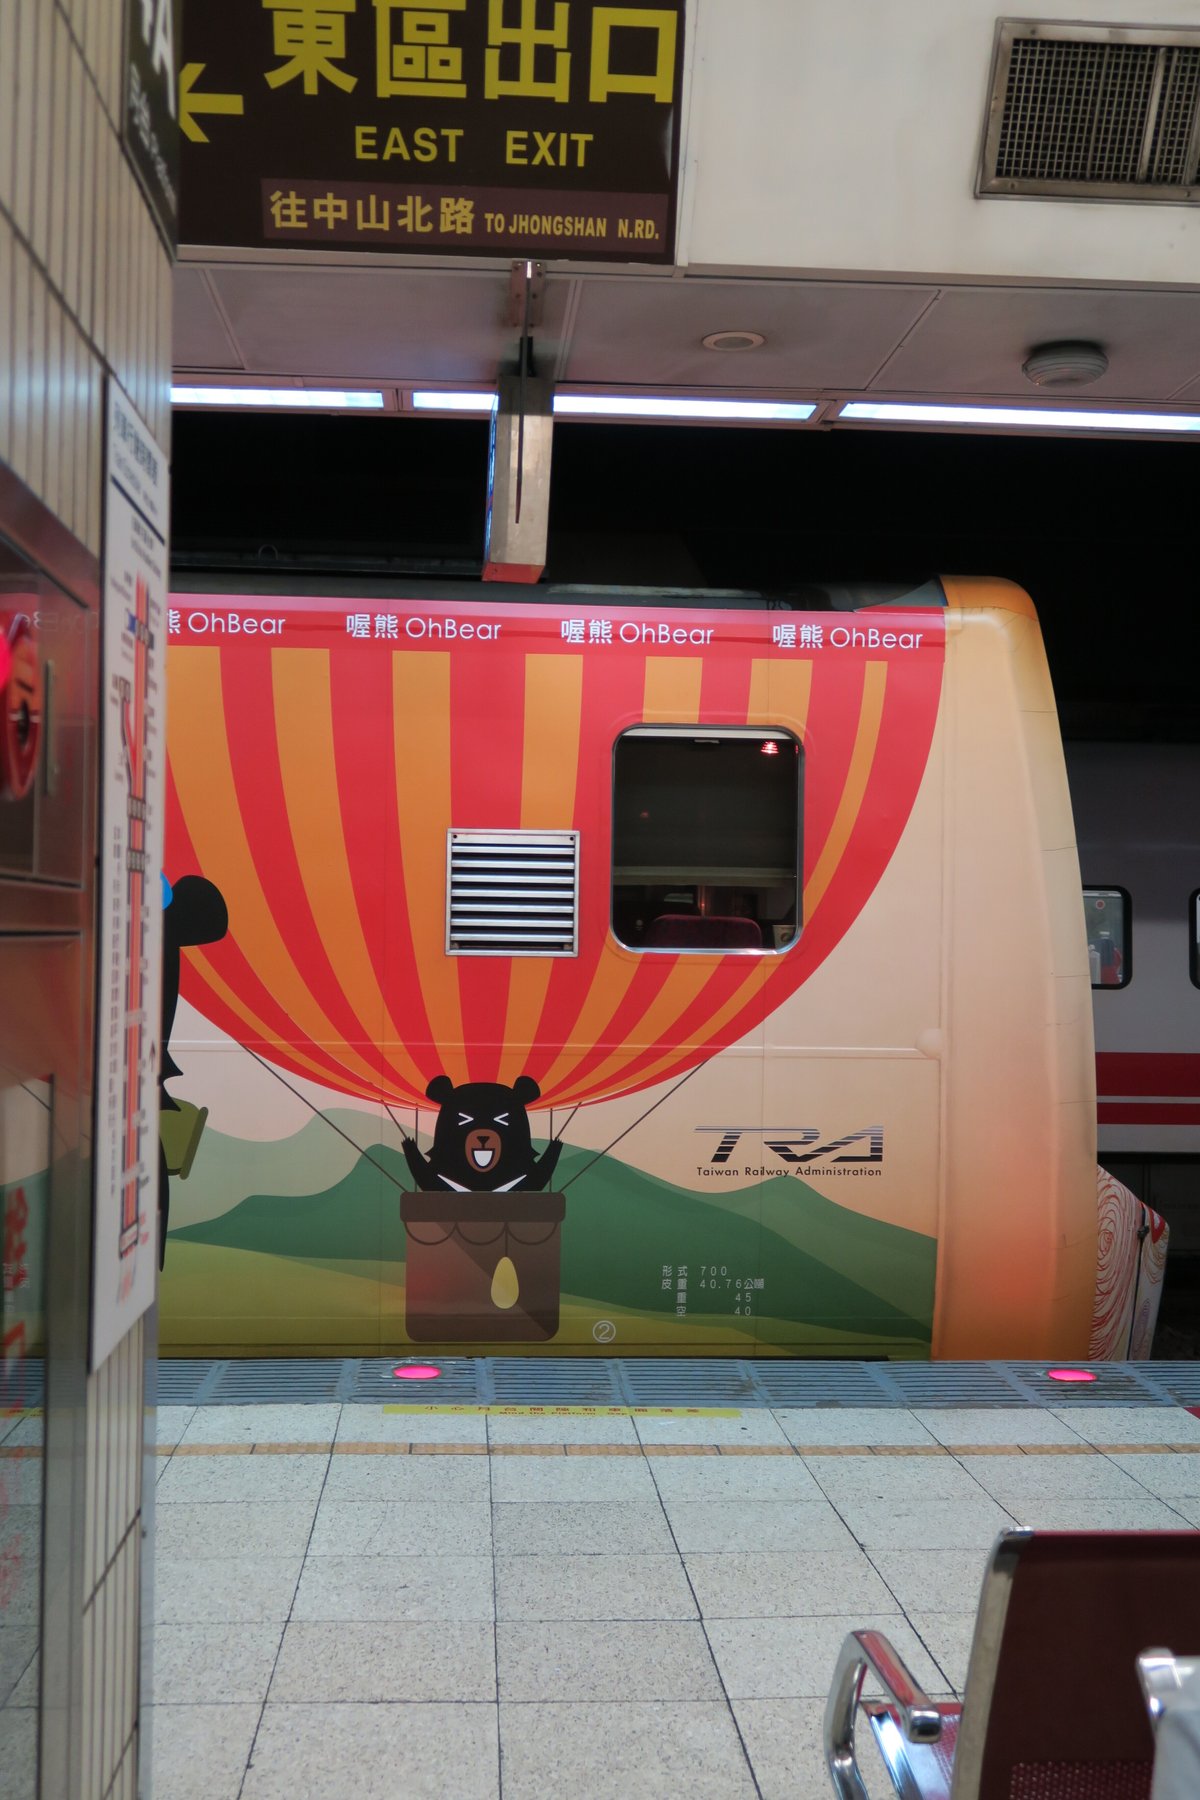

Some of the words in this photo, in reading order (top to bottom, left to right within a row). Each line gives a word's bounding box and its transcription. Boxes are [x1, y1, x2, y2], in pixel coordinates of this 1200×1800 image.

[263, 0, 678, 103] 東區出口
[355, 126, 464, 162] EAST
[505, 130, 594, 167] EXIT
[269, 190, 475, 235] 往中山北路
[485, 213, 505, 233] TO
[508, 214, 607, 237] JHONGSHAN
[188, 612, 286, 634] OhBear
[346, 613, 399, 639] 喔熊
[405, 617, 502, 640] OhBear
[561, 619, 613, 644] 喔熊
[619, 622, 714, 645] OhBear
[772, 624, 823, 649] 喔熊
[830, 627, 923, 649] OhBear
[694, 1126, 884, 1163] TRA
[697, 1167, 739, 1176] Taiwan
[744, 1166, 790, 1177] Railway
[795, 1166, 882, 1177] Administration
[662, 1265, 688, 1277] 形式
[700, 1266, 728, 1277] 700
[735, 1293, 752, 1303] 45
[734, 1306, 751, 1316] 40
